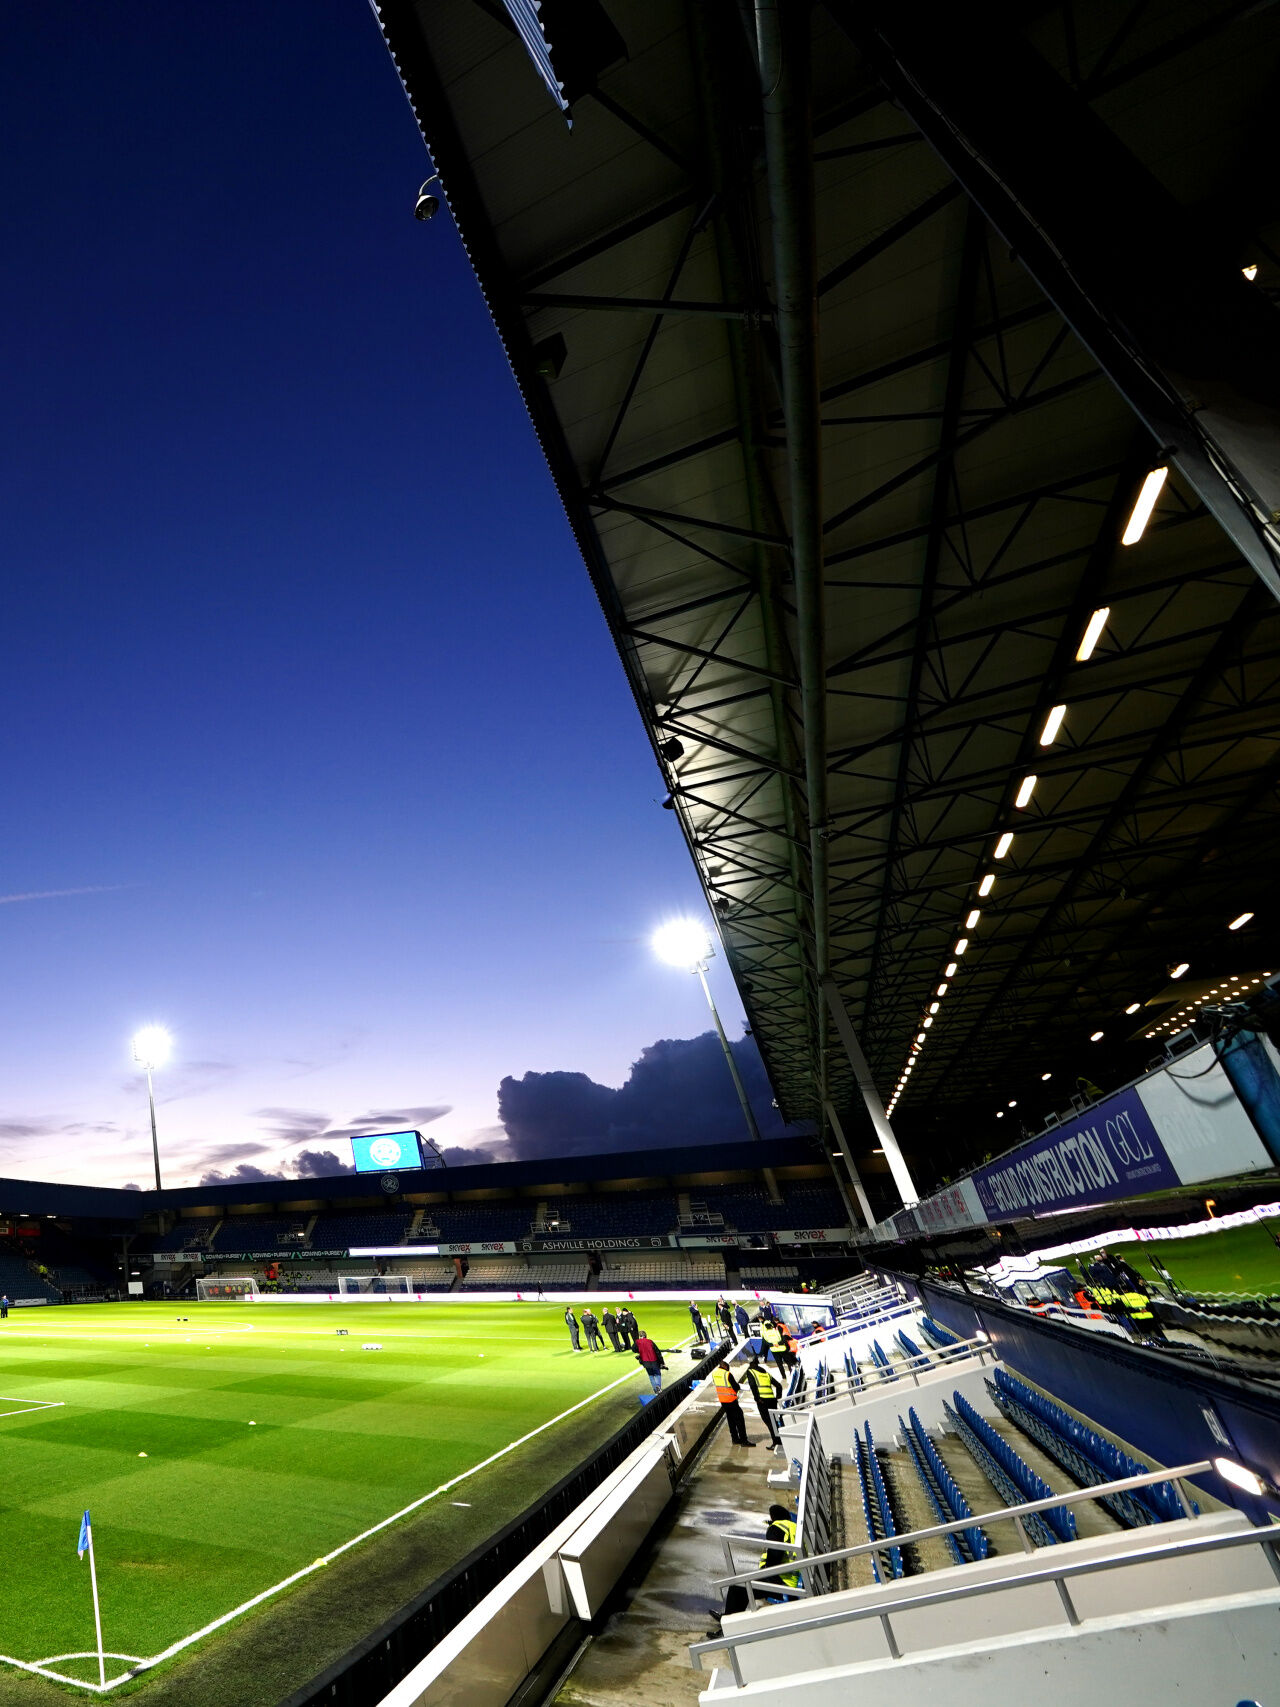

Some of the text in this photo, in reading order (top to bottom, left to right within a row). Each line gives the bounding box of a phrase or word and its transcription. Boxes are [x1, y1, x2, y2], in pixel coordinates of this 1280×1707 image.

[1106, 1110, 1154, 1166] GCL
[542, 1238, 640, 1250] ASHVILLE HOLDINGS
